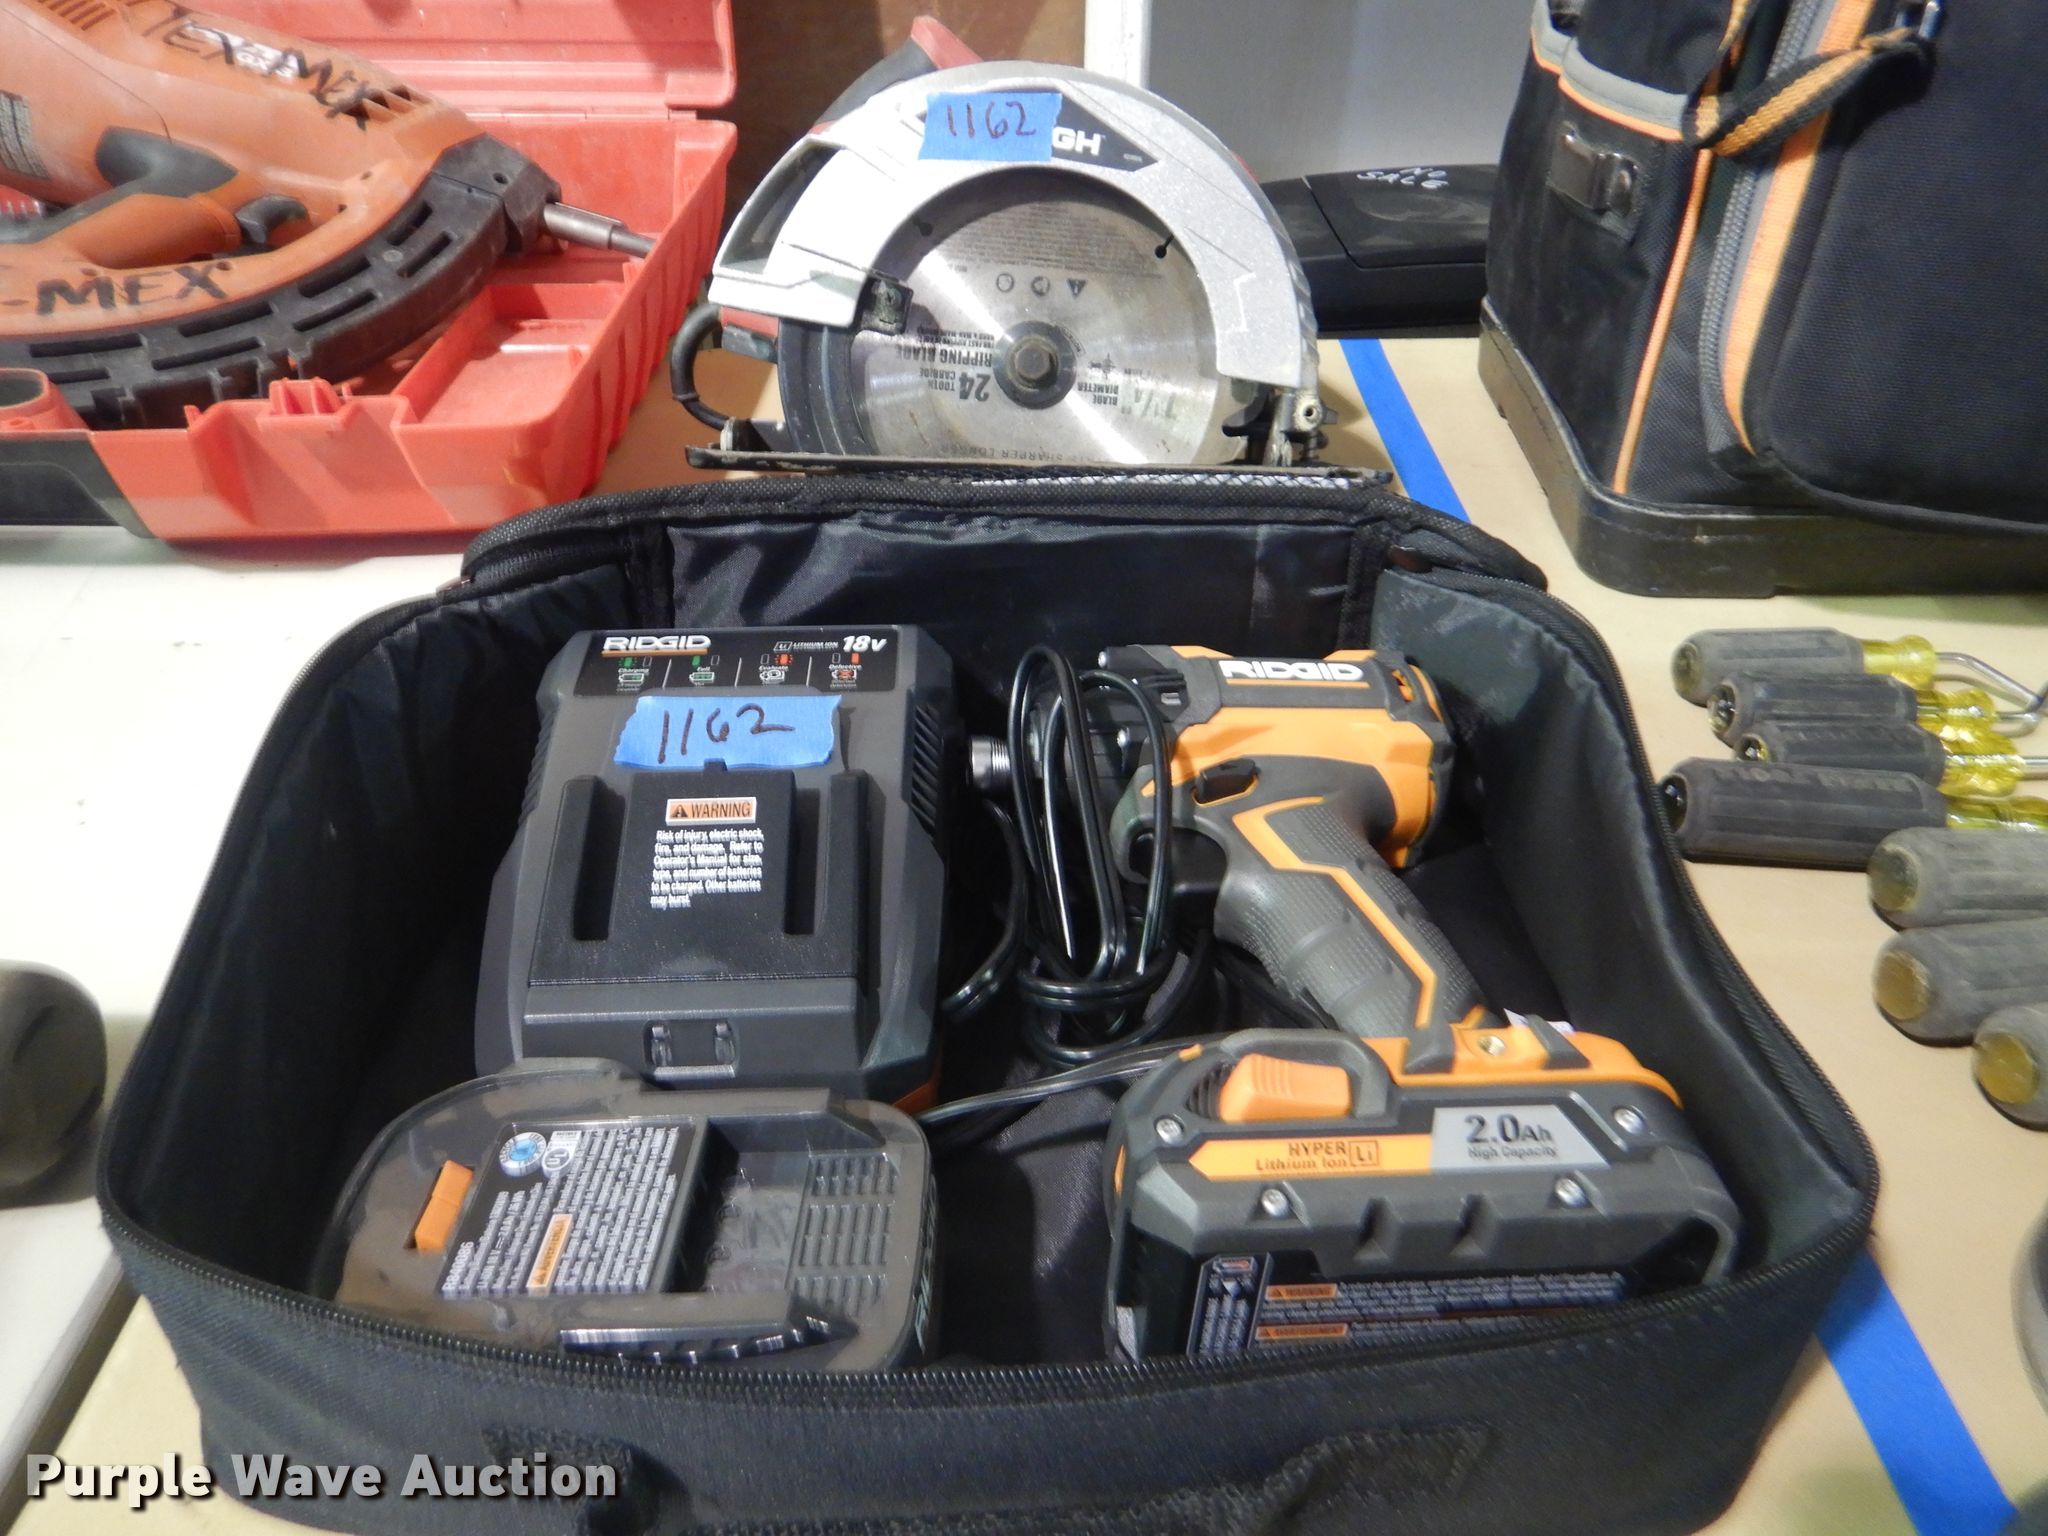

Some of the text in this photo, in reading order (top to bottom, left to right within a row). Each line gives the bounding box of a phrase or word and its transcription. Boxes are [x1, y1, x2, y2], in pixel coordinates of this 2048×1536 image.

[946, 101, 1037, 139] 1162
[895, 344, 993, 367] RIPPING BLADE
[920, 367, 956, 381] CARBIDE
[928, 378, 956, 392] TOOTH
[959, 372, 991, 402] 24
[1077, 382, 1119, 395] DIAMETER
[1092, 394, 1118, 406] BLADE
[1000, 449, 1063, 461] SHARPER
[603, 634, 712, 650] RIDGID
[1218, 660, 1364, 681] RIDGID
[657, 702, 795, 764] 1162
[691, 801, 751, 819] WARNING
[656, 829, 674, 841] Risk
[675, 829, 684, 841] of
[709, 828, 738, 841] electric
[673, 842, 690, 854] and
[730, 841, 752, 854] Refer
[753, 841, 764, 853] to
[697, 854, 727, 867] Manual
[729, 854, 741, 866] for
[673, 868, 688, 880] and
[689, 867, 717, 880] number
[718, 867, 727, 879] of
[727, 866, 762, 879] batteries
[651, 881, 660, 894] to
[660, 881, 670, 894] be
[705, 879, 727, 893] Other
[727, 879, 762, 892] batteries
[651, 895, 668, 909] may
[1288, 1141, 1373, 1161] HYPER Li
[1467, 1146, 1558, 1160] High Capacity
[1255, 1157, 1348, 1171] Lithium Ion
